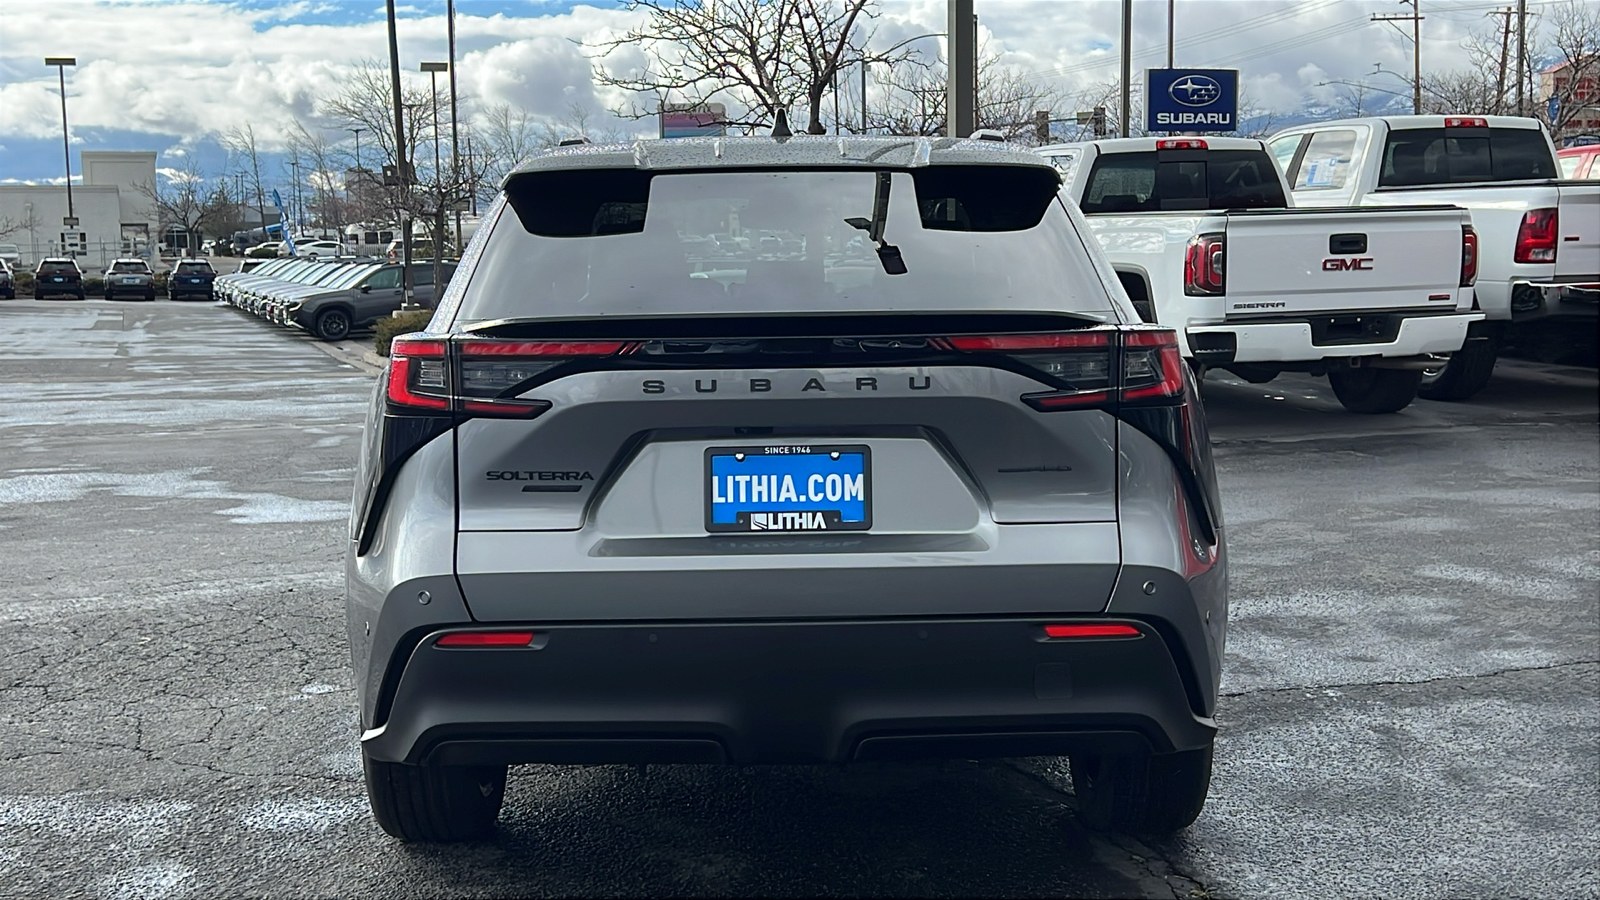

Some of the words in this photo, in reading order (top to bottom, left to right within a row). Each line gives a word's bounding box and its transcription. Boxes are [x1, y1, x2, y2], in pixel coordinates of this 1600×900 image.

[1157, 112, 1230, 124] SUBARU
[1322, 258, 1374, 271] GMC
[642, 376, 931, 394] SUBARU
[764, 446, 790, 454] SINCE
[791, 446, 811, 454] 1946
[486, 470, 595, 481] SOLTERRA
[712, 473, 865, 504] LITHIA.COM
[767, 512, 827, 530] LITHIA
